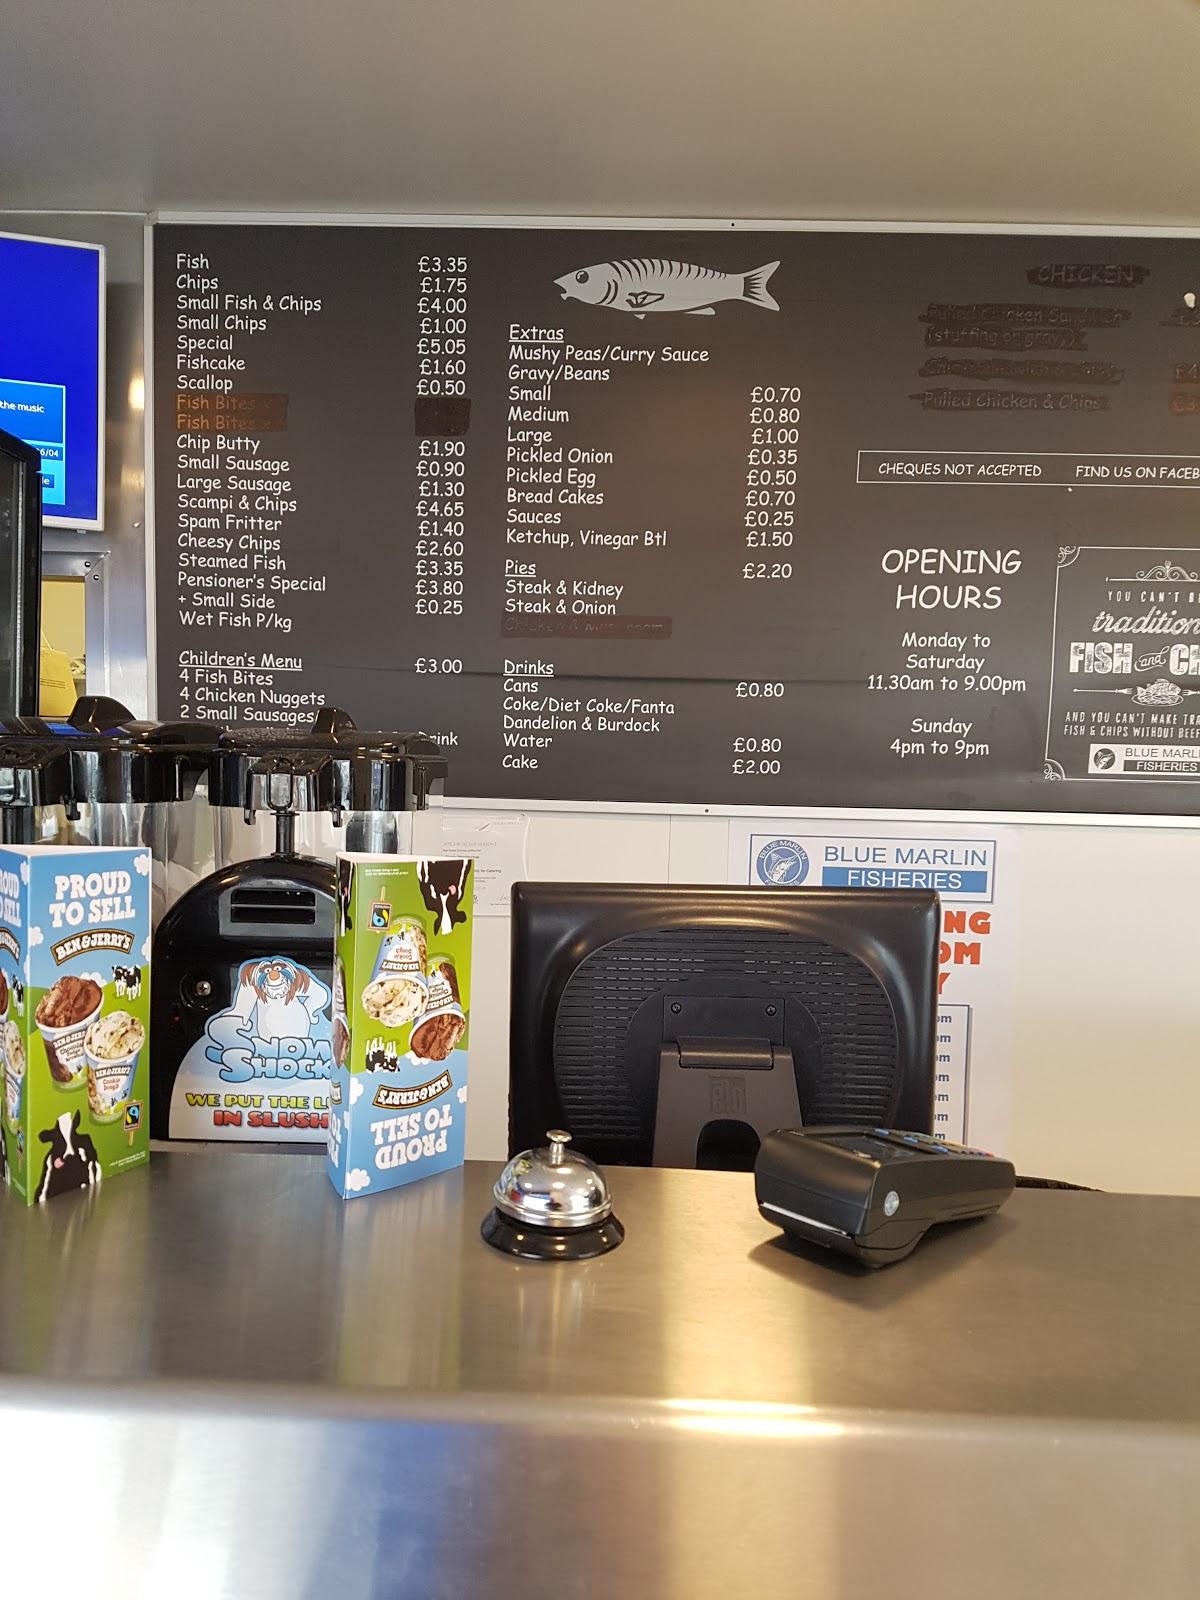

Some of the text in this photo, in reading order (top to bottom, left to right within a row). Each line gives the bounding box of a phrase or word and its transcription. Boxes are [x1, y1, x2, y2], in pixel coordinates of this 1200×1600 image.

[177, 253, 209, 269] Fish
[417, 256, 467, 273] £3.35
[176, 273, 218, 294] Chips
[420, 277, 467, 293] £1.75
[177, 294, 321, 315] Small Fish Chips
[417, 297, 467, 314] £4.00
[177, 314, 266, 335] Small Chips
[420, 317, 466, 334] £1.00
[508, 324, 564, 343] Extras
[177, 334, 233, 354] Special
[416, 338, 466, 355] £5.05
[177, 354, 245, 370] Fishcake
[509, 344, 709, 366] Mushy Peas/Curry Sauce
[419, 358, 466, 375] £1.60
[508, 364, 610, 385] Gravy/Beans
[177, 374, 233, 394] Scallop
[416, 379, 465, 396] £0.50
[509, 385, 551, 401] Small
[750, 386, 801, 403] £0.70
[0, 400, 45, 413] the music
[508, 406, 569, 422] Medium
[749, 407, 800, 424] £0.80
[177, 433, 260, 455] Chip Butty
[508, 426, 552, 447] Large
[751, 428, 799, 445] £1.00
[419, 440, 465, 457] £1.90
[507, 446, 613, 464] Pickled Onion
[747, 449, 797, 465] £0.35
[177, 454, 290, 476] Small Sausage
[416, 460, 465, 477] £0.90
[878, 462, 1042, 477] CHEQUES NOT ACCEPTED
[1076, 465, 1200, 479] FIND US ON FACEB
[177, 473, 292, 496] Large Sausage
[507, 467, 596, 488] Pickled Egg
[746, 469, 796, 486] £0.50
[418, 480, 464, 497] £1.30
[507, 487, 604, 504] Bread Cakes
[178, 494, 297, 516] Scampi Chips
[745, 490, 795, 507] £0.70
[416, 500, 464, 517] £4.65
[506, 508, 561, 524] Sauces
[178, 513, 282, 532] Spam Fritter
[744, 510, 794, 527] £0.25
[418, 520, 464, 537] £1.40
[178, 532, 280, 554] Cheesy Chips
[507, 528, 666, 550] Ketchup, Vinegar Btl
[746, 531, 793, 547] £1.50
[415, 540, 464, 556] £2.60
[178, 553, 286, 570] Steamed Fish
[415, 560, 463, 576] £3.35
[505, 559, 536, 574] Pies
[882, 548, 1021, 574] OPENING
[742, 563, 792, 579] £2.20
[178, 571, 326, 594] Pensioner's Special
[415, 579, 463, 595] £3.80
[505, 579, 623, 600] Steak Kidney
[192, 592, 275, 609] Small Side
[896, 585, 1001, 609] HOURS
[1108, 591, 1179, 603] YOU CAN'T
[415, 599, 463, 615] £0.25
[505, 598, 616, 615] Steak Onion
[179, 610, 292, 633] Wet Fish P/kg
[902, 632, 990, 652] Monday to
[178, 651, 303, 670] Children's Menu
[414, 658, 462, 673] £3.00
[906, 653, 985, 673] Saturday
[1069, 641, 1133, 674] FISH
[504, 659, 554, 674] Drinks
[195, 669, 273, 686] Fish Bites
[504, 678, 538, 693] Cans
[868, 675, 1026, 695] 11.30am to 9.00pm
[195, 687, 325, 709] Chicken Nuggets
[735, 682, 784, 698] £0.80
[503, 696, 674, 714] Coke/Diet Coke/Fanta
[196, 706, 238, 722] Small
[1065, 712, 1177, 724] AND YOU CAN'T MAKE
[504, 714, 660, 732] Dandelion Burdock
[911, 718, 972, 738] Sunday
[1064, 725, 1174, 738] FISH CHIPS WITHOUT
[503, 733, 552, 748] Water
[733, 737, 781, 753] £0.80
[890, 739, 989, 759] 4pm to 9pm
[1125, 748, 1159, 757] BLUE
[502, 754, 538, 769] Cake
[732, 759, 780, 774] £2.00
[1136, 761, 1198, 771] FISHERIES
[825, 846, 987, 866] BLUE MARLIN
[55, 870, 131, 900] PROUD
[847, 870, 962, 889] FISHERIES
[49, 895, 135, 928] TO SELL
[55, 932, 131, 960] BEN&JERRY'S
[378, 1075, 449, 1105] BEN&JERRY'S
[185, 1093, 309, 1109] WE PUT THE
[213, 1110, 329, 1128] IN SLUSH
[424, 1104, 453, 1131] TO
[370, 1112, 421, 1145] SELL
[375, 1130, 447, 1170] PROUD
